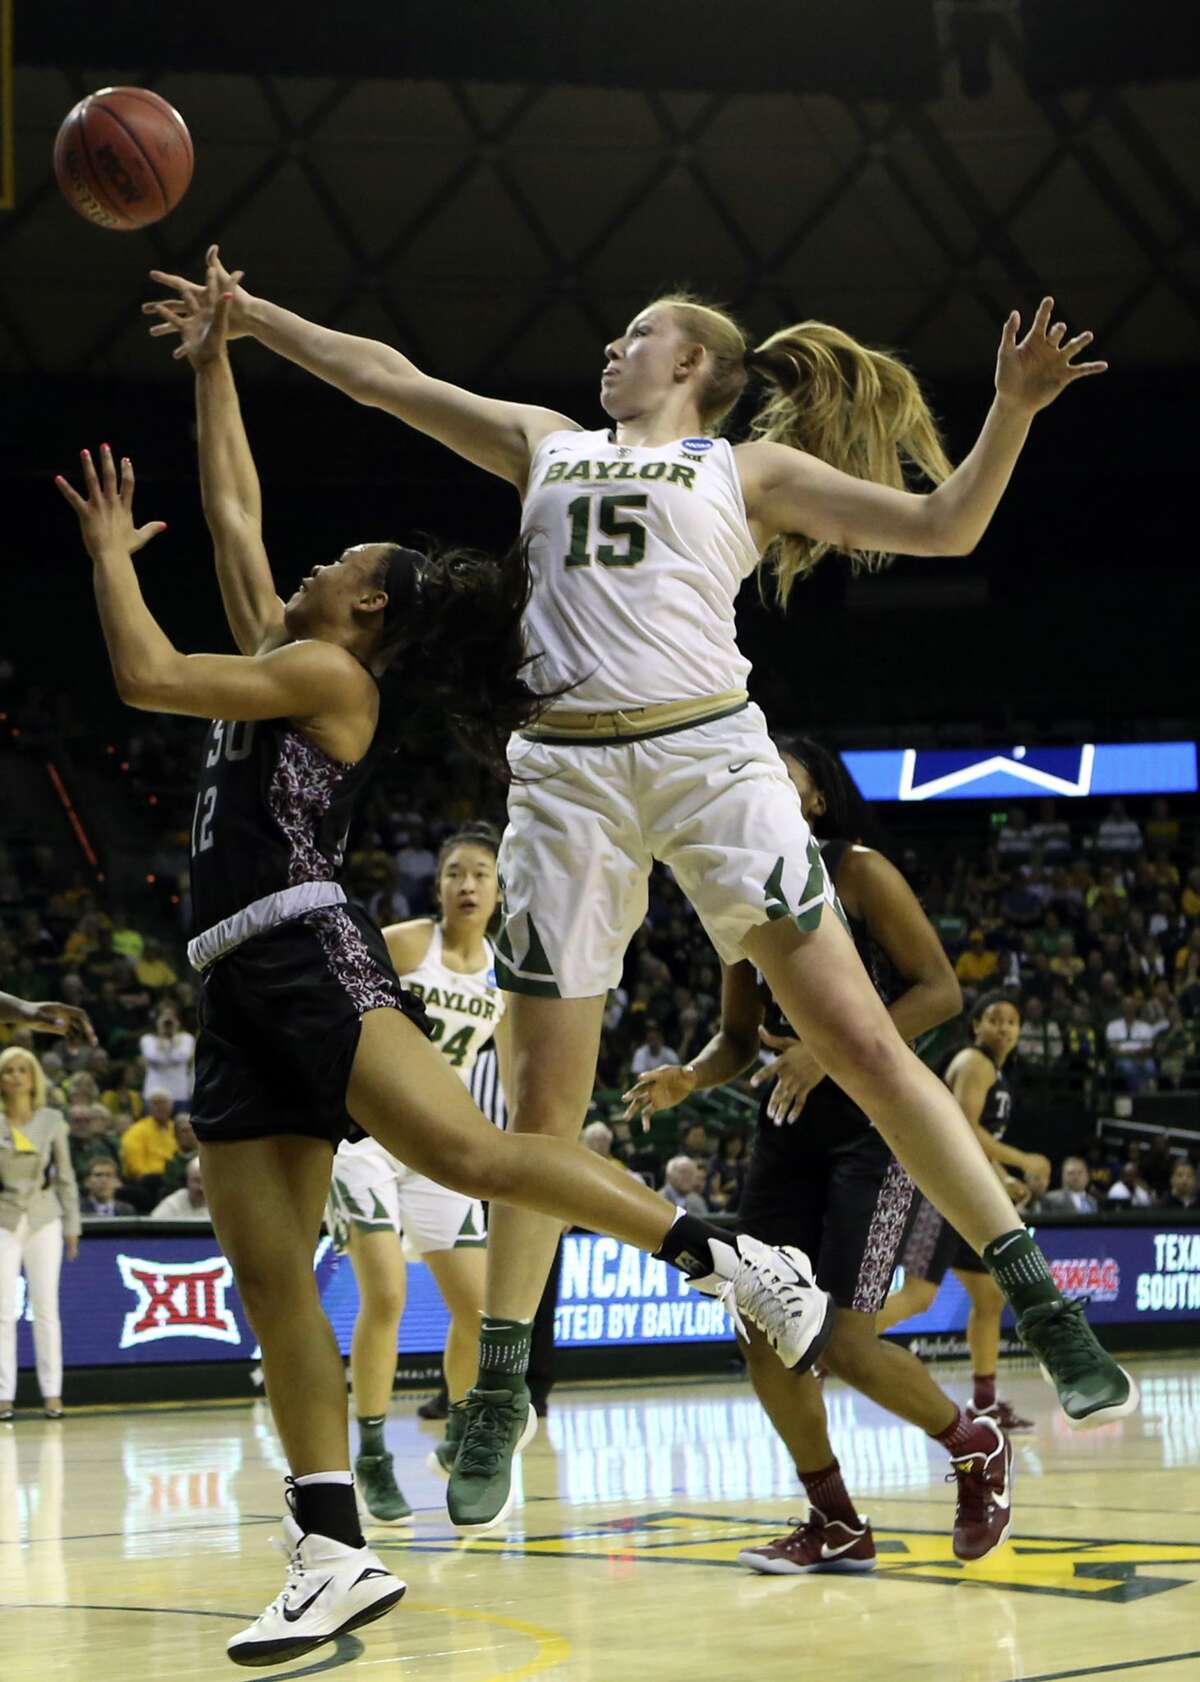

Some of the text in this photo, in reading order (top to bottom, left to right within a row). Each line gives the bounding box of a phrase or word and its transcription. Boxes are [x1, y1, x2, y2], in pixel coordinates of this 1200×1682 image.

[541, 459, 696, 491] BAYLOR
[564, 493, 649, 569] 15
[191, 786, 218, 858] 12
[409, 981, 496, 1021] BAYLOR
[561, 1236, 668, 1298] NCAA
[607, 1303, 640, 1339] BY
[641, 1301, 725, 1337] BAYLOR
